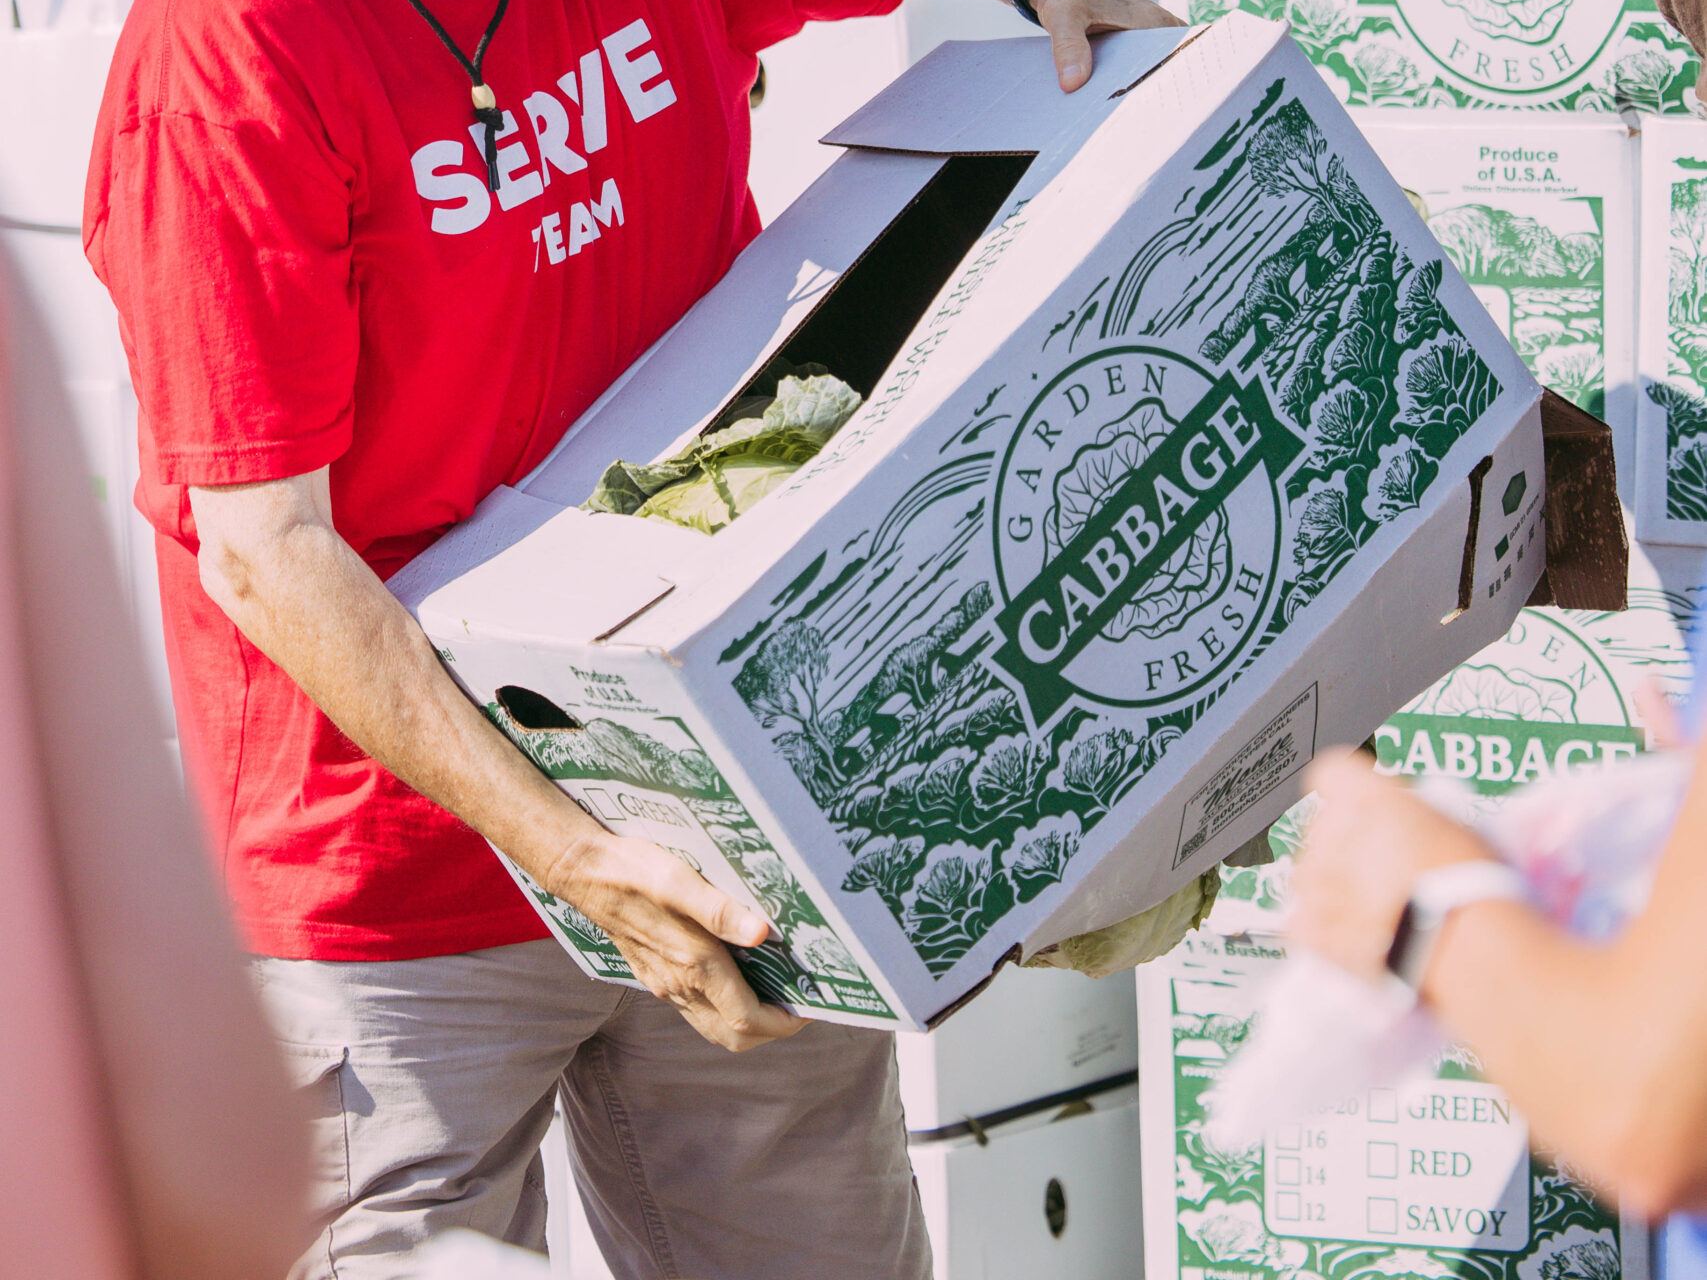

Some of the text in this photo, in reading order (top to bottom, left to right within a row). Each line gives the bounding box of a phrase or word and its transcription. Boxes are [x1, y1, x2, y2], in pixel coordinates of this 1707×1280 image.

[1448, 38, 1574, 84] FRESH
[411, 18, 677, 235] SERVE
[1479, 146, 1559, 162] Produce
[1477, 167, 1561, 182] of U.S.A.
[532, 178, 625, 273] TEAM
[929, 198, 1032, 328] HANDLE
[950, 220, 1028, 317] FRESH
[863, 335, 933, 420] WITH
[1007, 363, 1168, 543] GARDEN
[1017, 399, 1261, 664] CABBAGE
[1144, 567, 1264, 691] FRESH
[570, 665, 627, 686] Produce
[1505, 622, 1597, 691] DEN
[1254, 692, 1310, 745] CONTAINERS
[1268, 717, 1292, 740] CALL
[1210, 775, 1280, 834] montepkg.com
[1212, 750, 1298, 826] 800-653-2807
[617, 792, 693, 830] GREEN
[608, 961, 632, 973] CAN
[1224, 941, 1287, 959] Bushel
[842, 995, 888, 1013] MEXICO
[1408, 1094, 1512, 1125] GREEN
[1305, 1130, 1328, 1149] 16
[1305, 1166, 1326, 1185] 14
[1409, 1148, 1472, 1177] RED
[1305, 1202, 1326, 1222] 12
[1406, 1204, 1507, 1237] SAVOY
